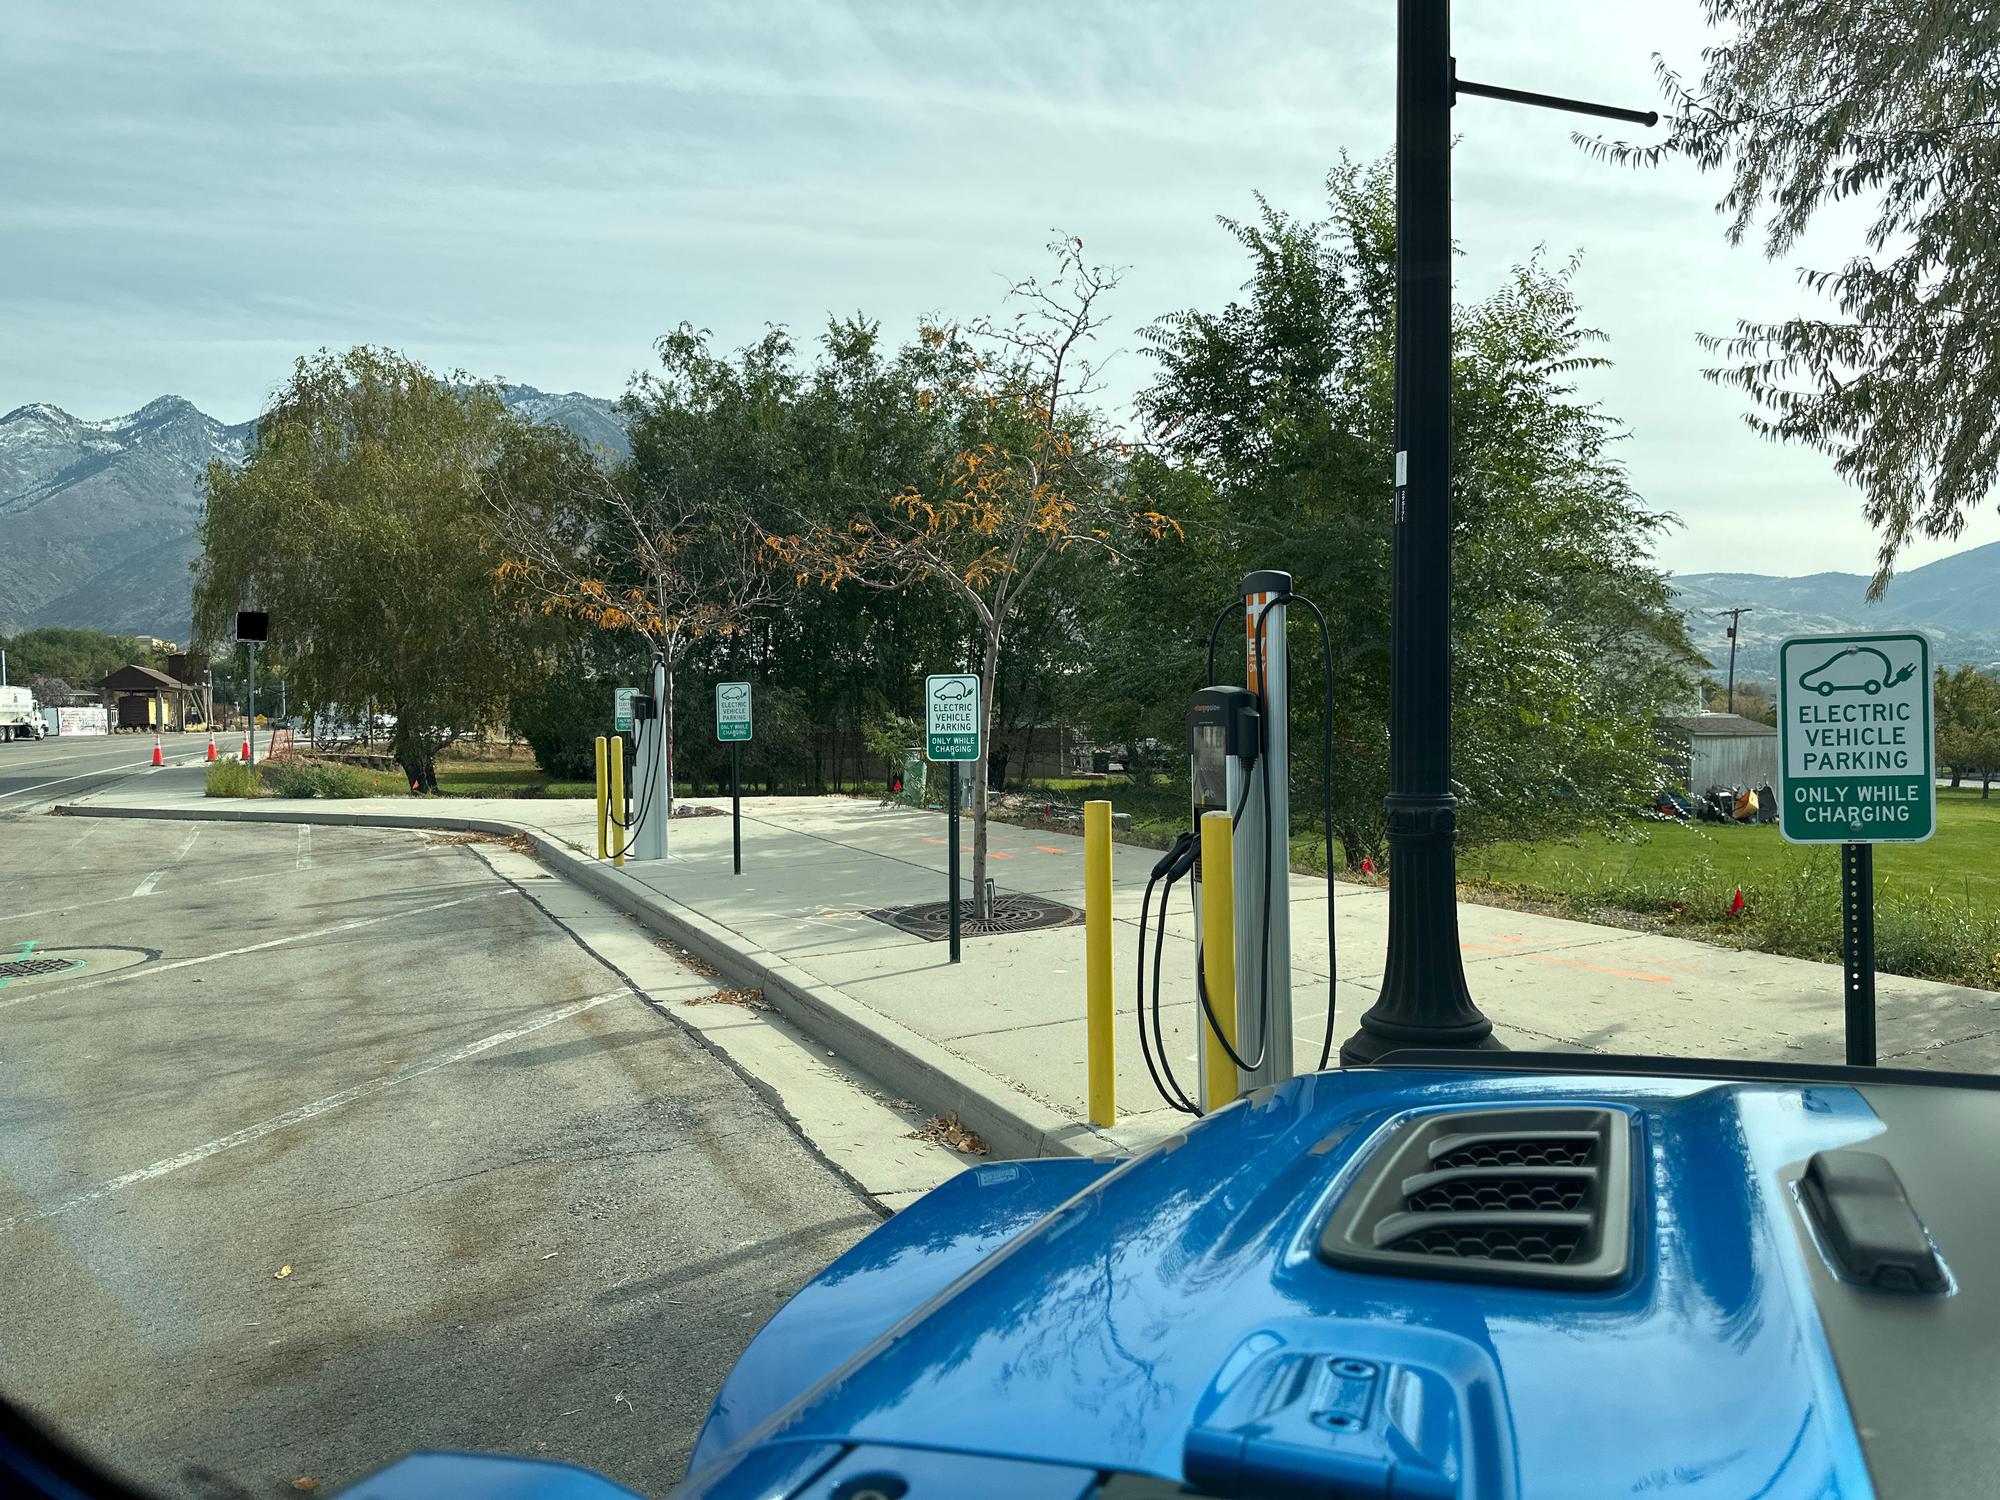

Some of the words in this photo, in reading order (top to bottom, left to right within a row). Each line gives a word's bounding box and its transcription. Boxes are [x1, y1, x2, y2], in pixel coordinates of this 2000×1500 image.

[1249, 663, 1267, 672] ONY
[933, 703, 972, 712] ELECTRIC
[935, 713, 971, 722] VEHICLE
[1799, 702, 1910, 724] ELECTRIC
[935, 723, 972, 731] PARKING
[931, 737, 952, 745] ONLY
[953, 737, 975, 745] WHILE
[1805, 726, 1906, 747] VEHICLE
[935, 745, 972, 753] CHARGING
[1803, 751, 1908, 771] PARKING
[1794, 786, 1851, 803] ONLY
[1857, 785, 1919, 802] WHILE
[1804, 805, 1910, 823] CHARGING
